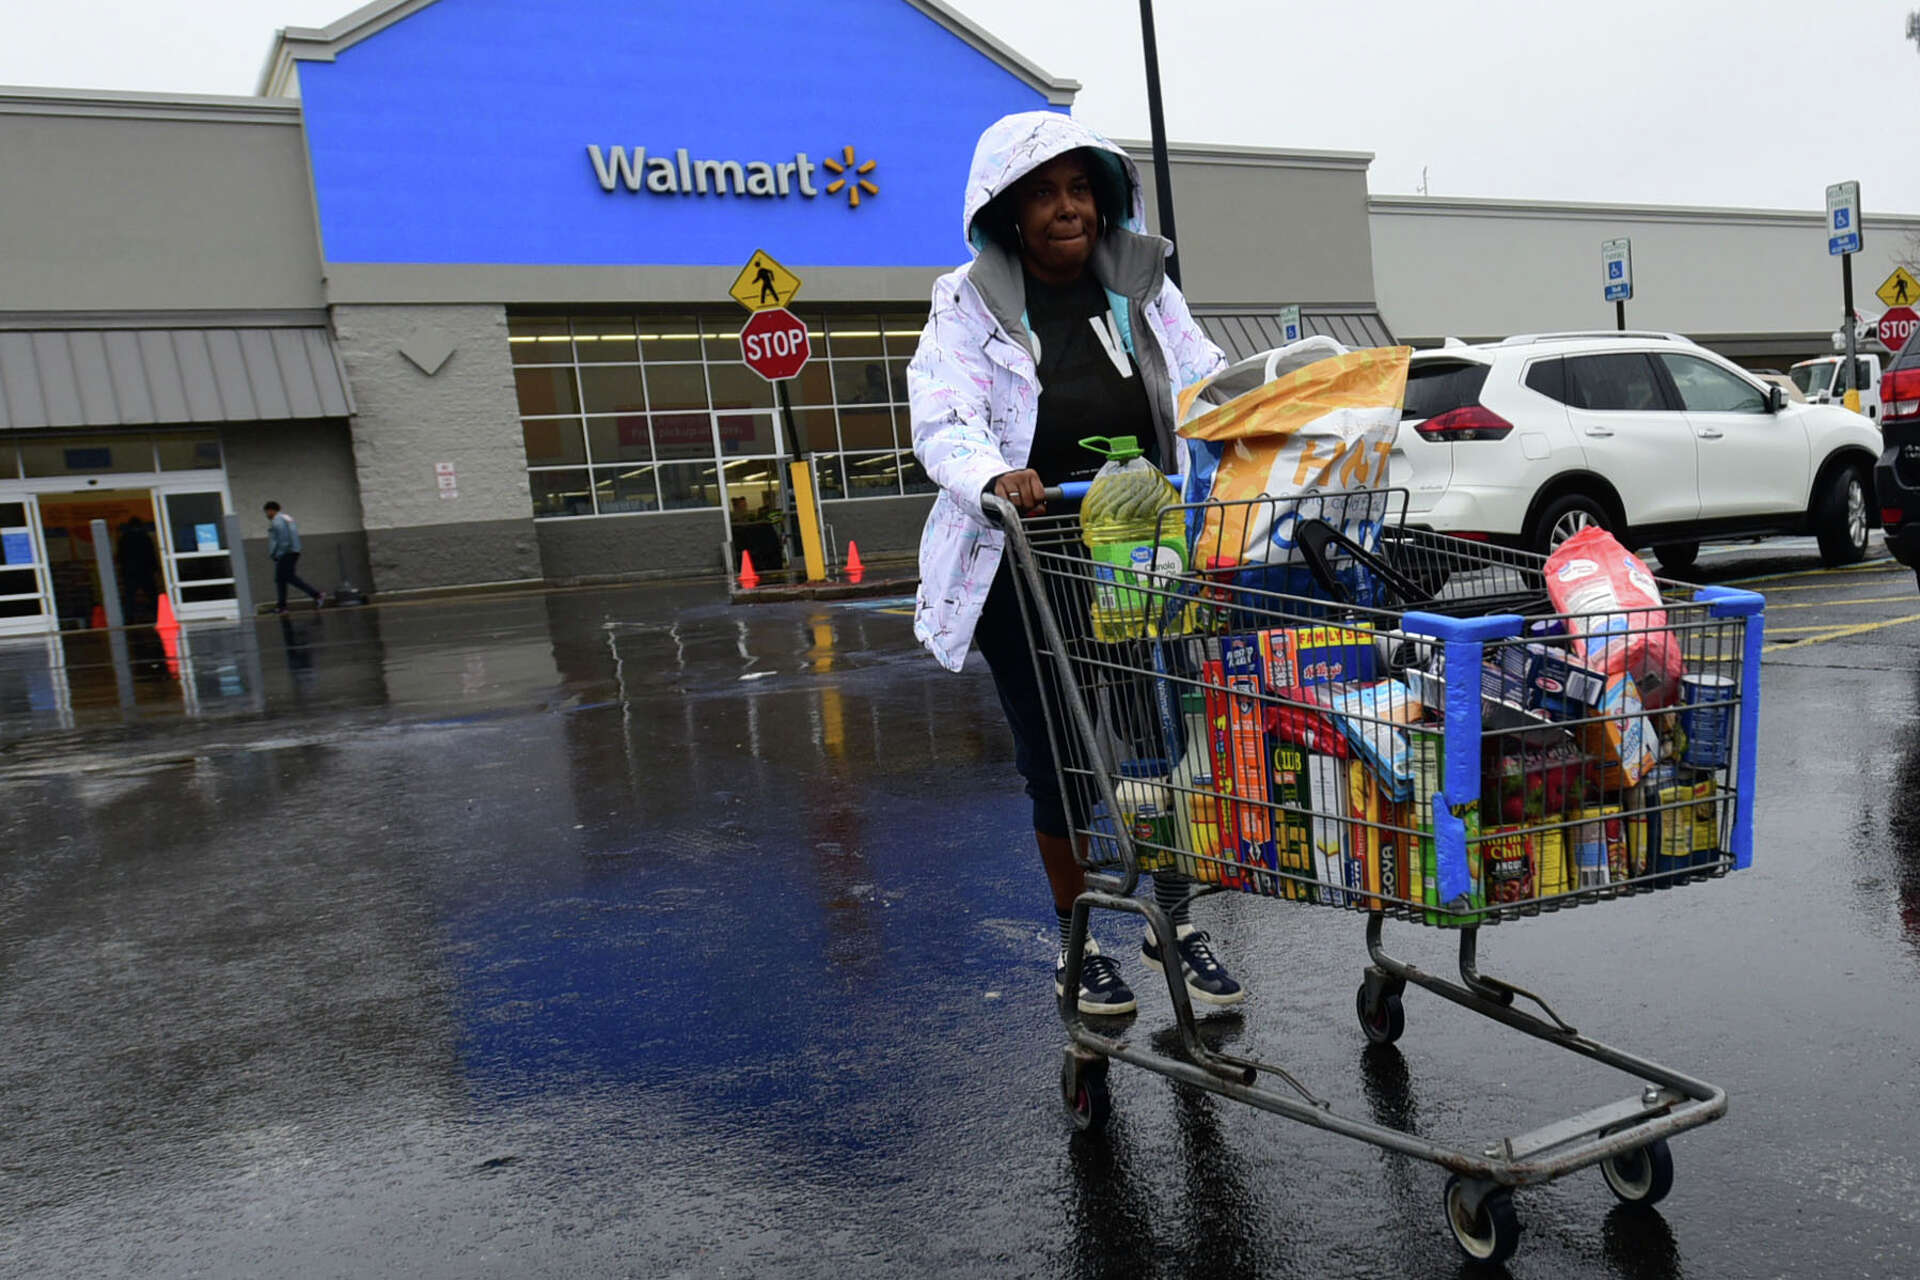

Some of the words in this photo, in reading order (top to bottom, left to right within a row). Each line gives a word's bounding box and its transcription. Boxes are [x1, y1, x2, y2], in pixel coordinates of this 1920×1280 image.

[587, 144, 817, 197] Walmart
[747, 329, 803, 360] STOP
[1144, 561, 1176, 574] Cnola
[1298, 628, 1341, 645] FAMLY
[1274, 748, 1302, 771] CLUB
[1382, 845, 1394, 899] GOYA
